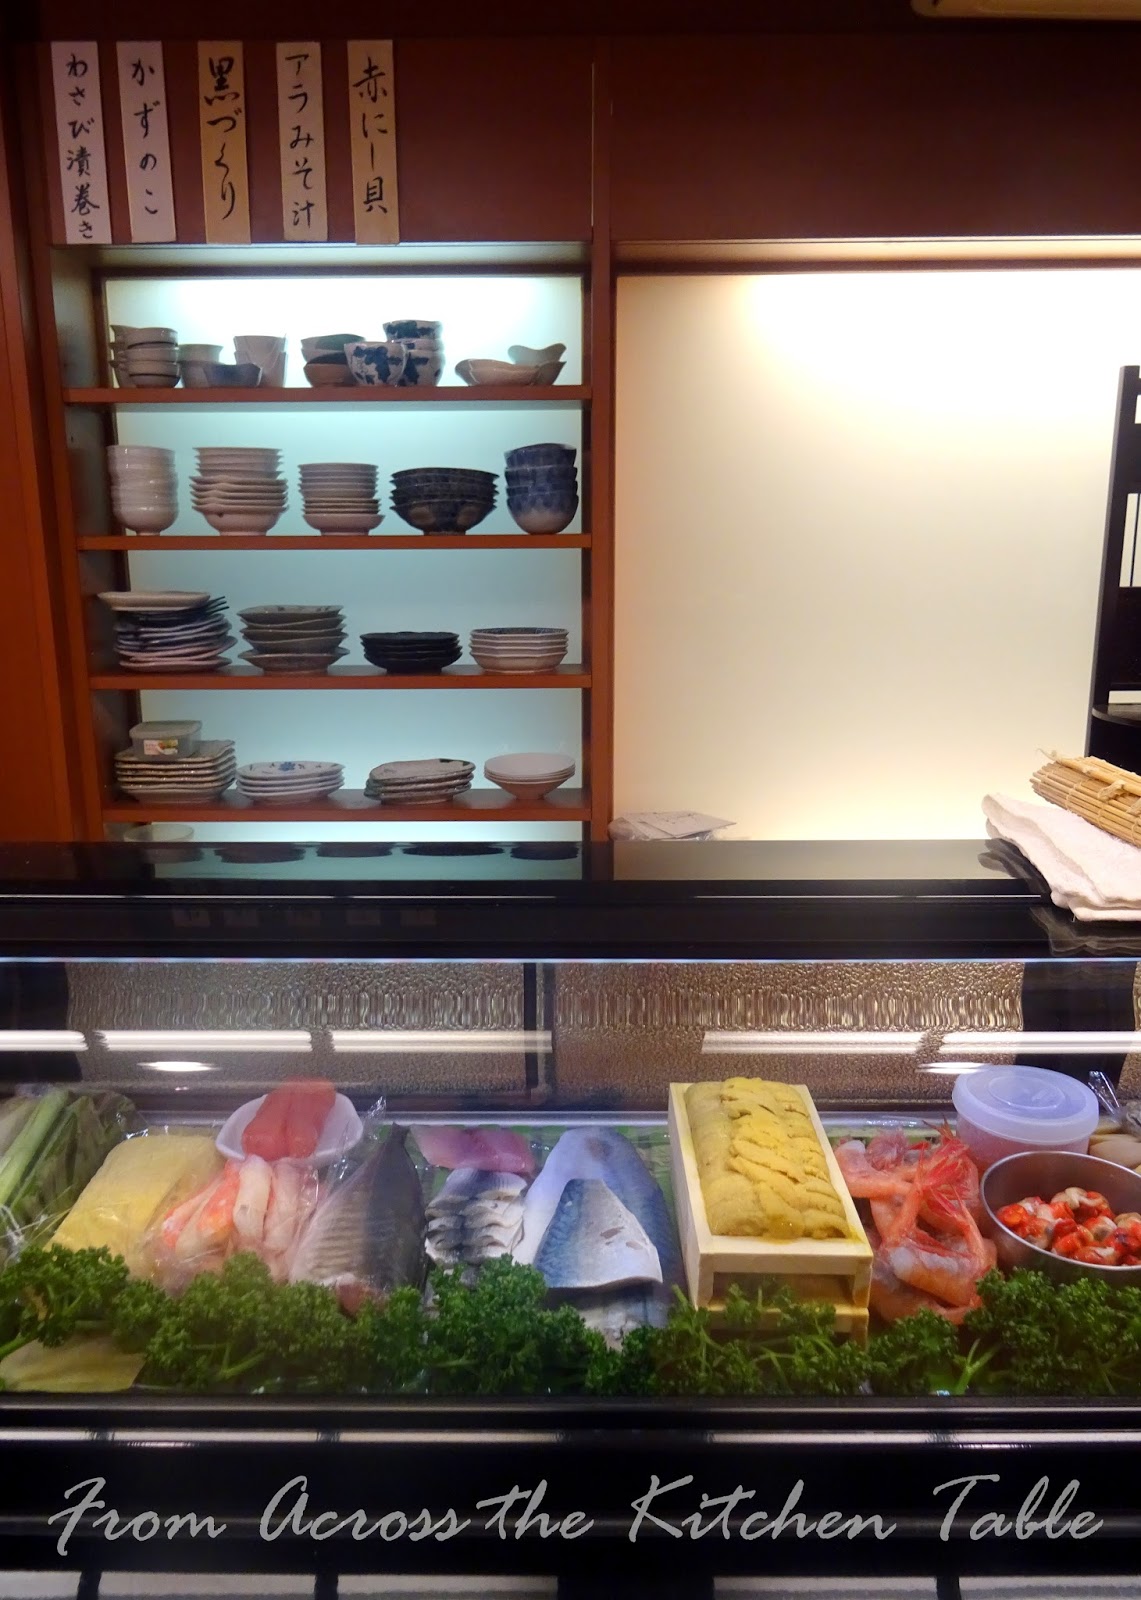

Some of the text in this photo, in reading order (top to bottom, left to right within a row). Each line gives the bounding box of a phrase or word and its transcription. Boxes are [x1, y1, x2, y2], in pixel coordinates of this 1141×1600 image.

[131, 57, 160, 215] かずのこ
[204, 56, 240, 220] 黒づくり
[285, 53, 315, 229] アラみそ汁
